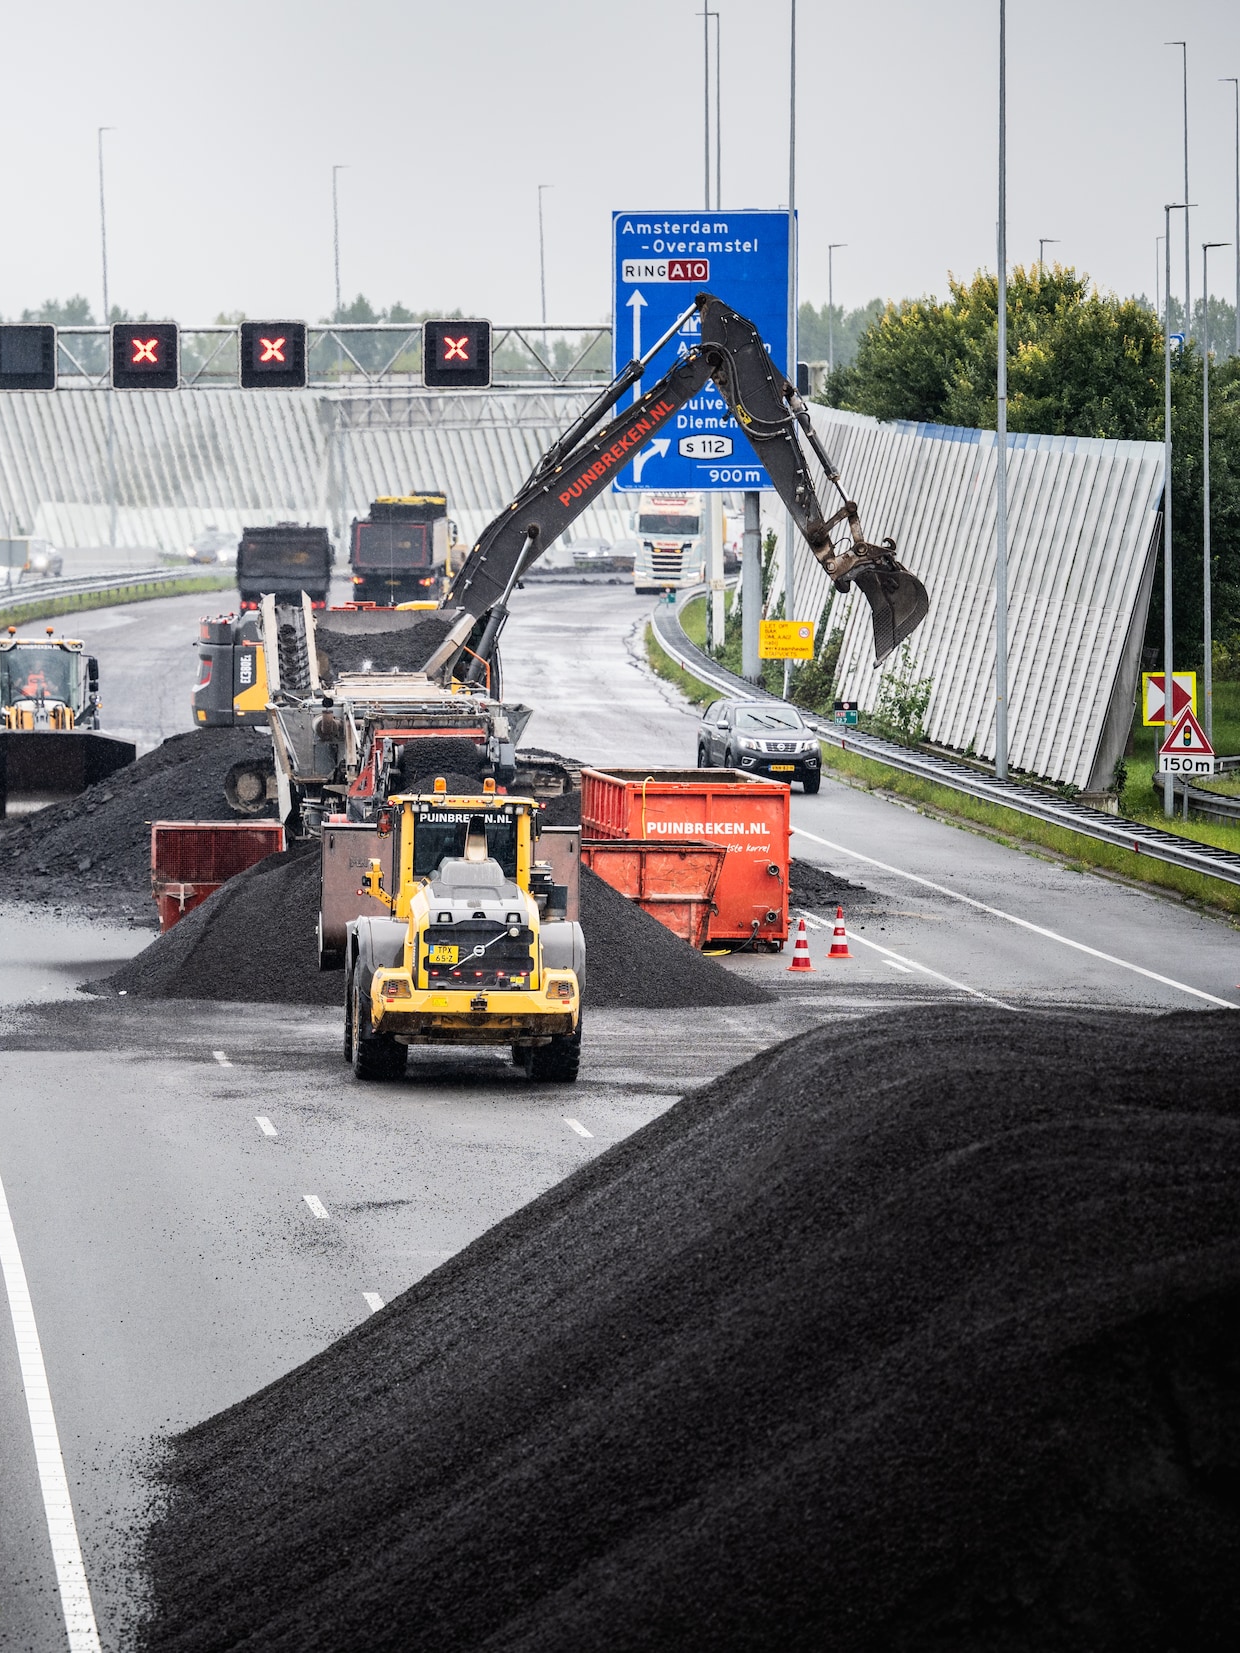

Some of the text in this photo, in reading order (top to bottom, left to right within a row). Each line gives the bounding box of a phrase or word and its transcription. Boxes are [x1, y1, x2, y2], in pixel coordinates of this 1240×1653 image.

[622, 221, 729, 234] Amsterdam
[625, 263, 706, 278] RING A10
[677, 415, 739, 429] Diemen
[558, 400, 675, 507] PUINBREKEN.NL
[419, 813, 513, 824] PUINBREN.NL
[646, 821, 771, 835] PUINBREKEN.NL
[437, 946, 452, 954] TPX
[435, 955, 453, 963] 65-Z
